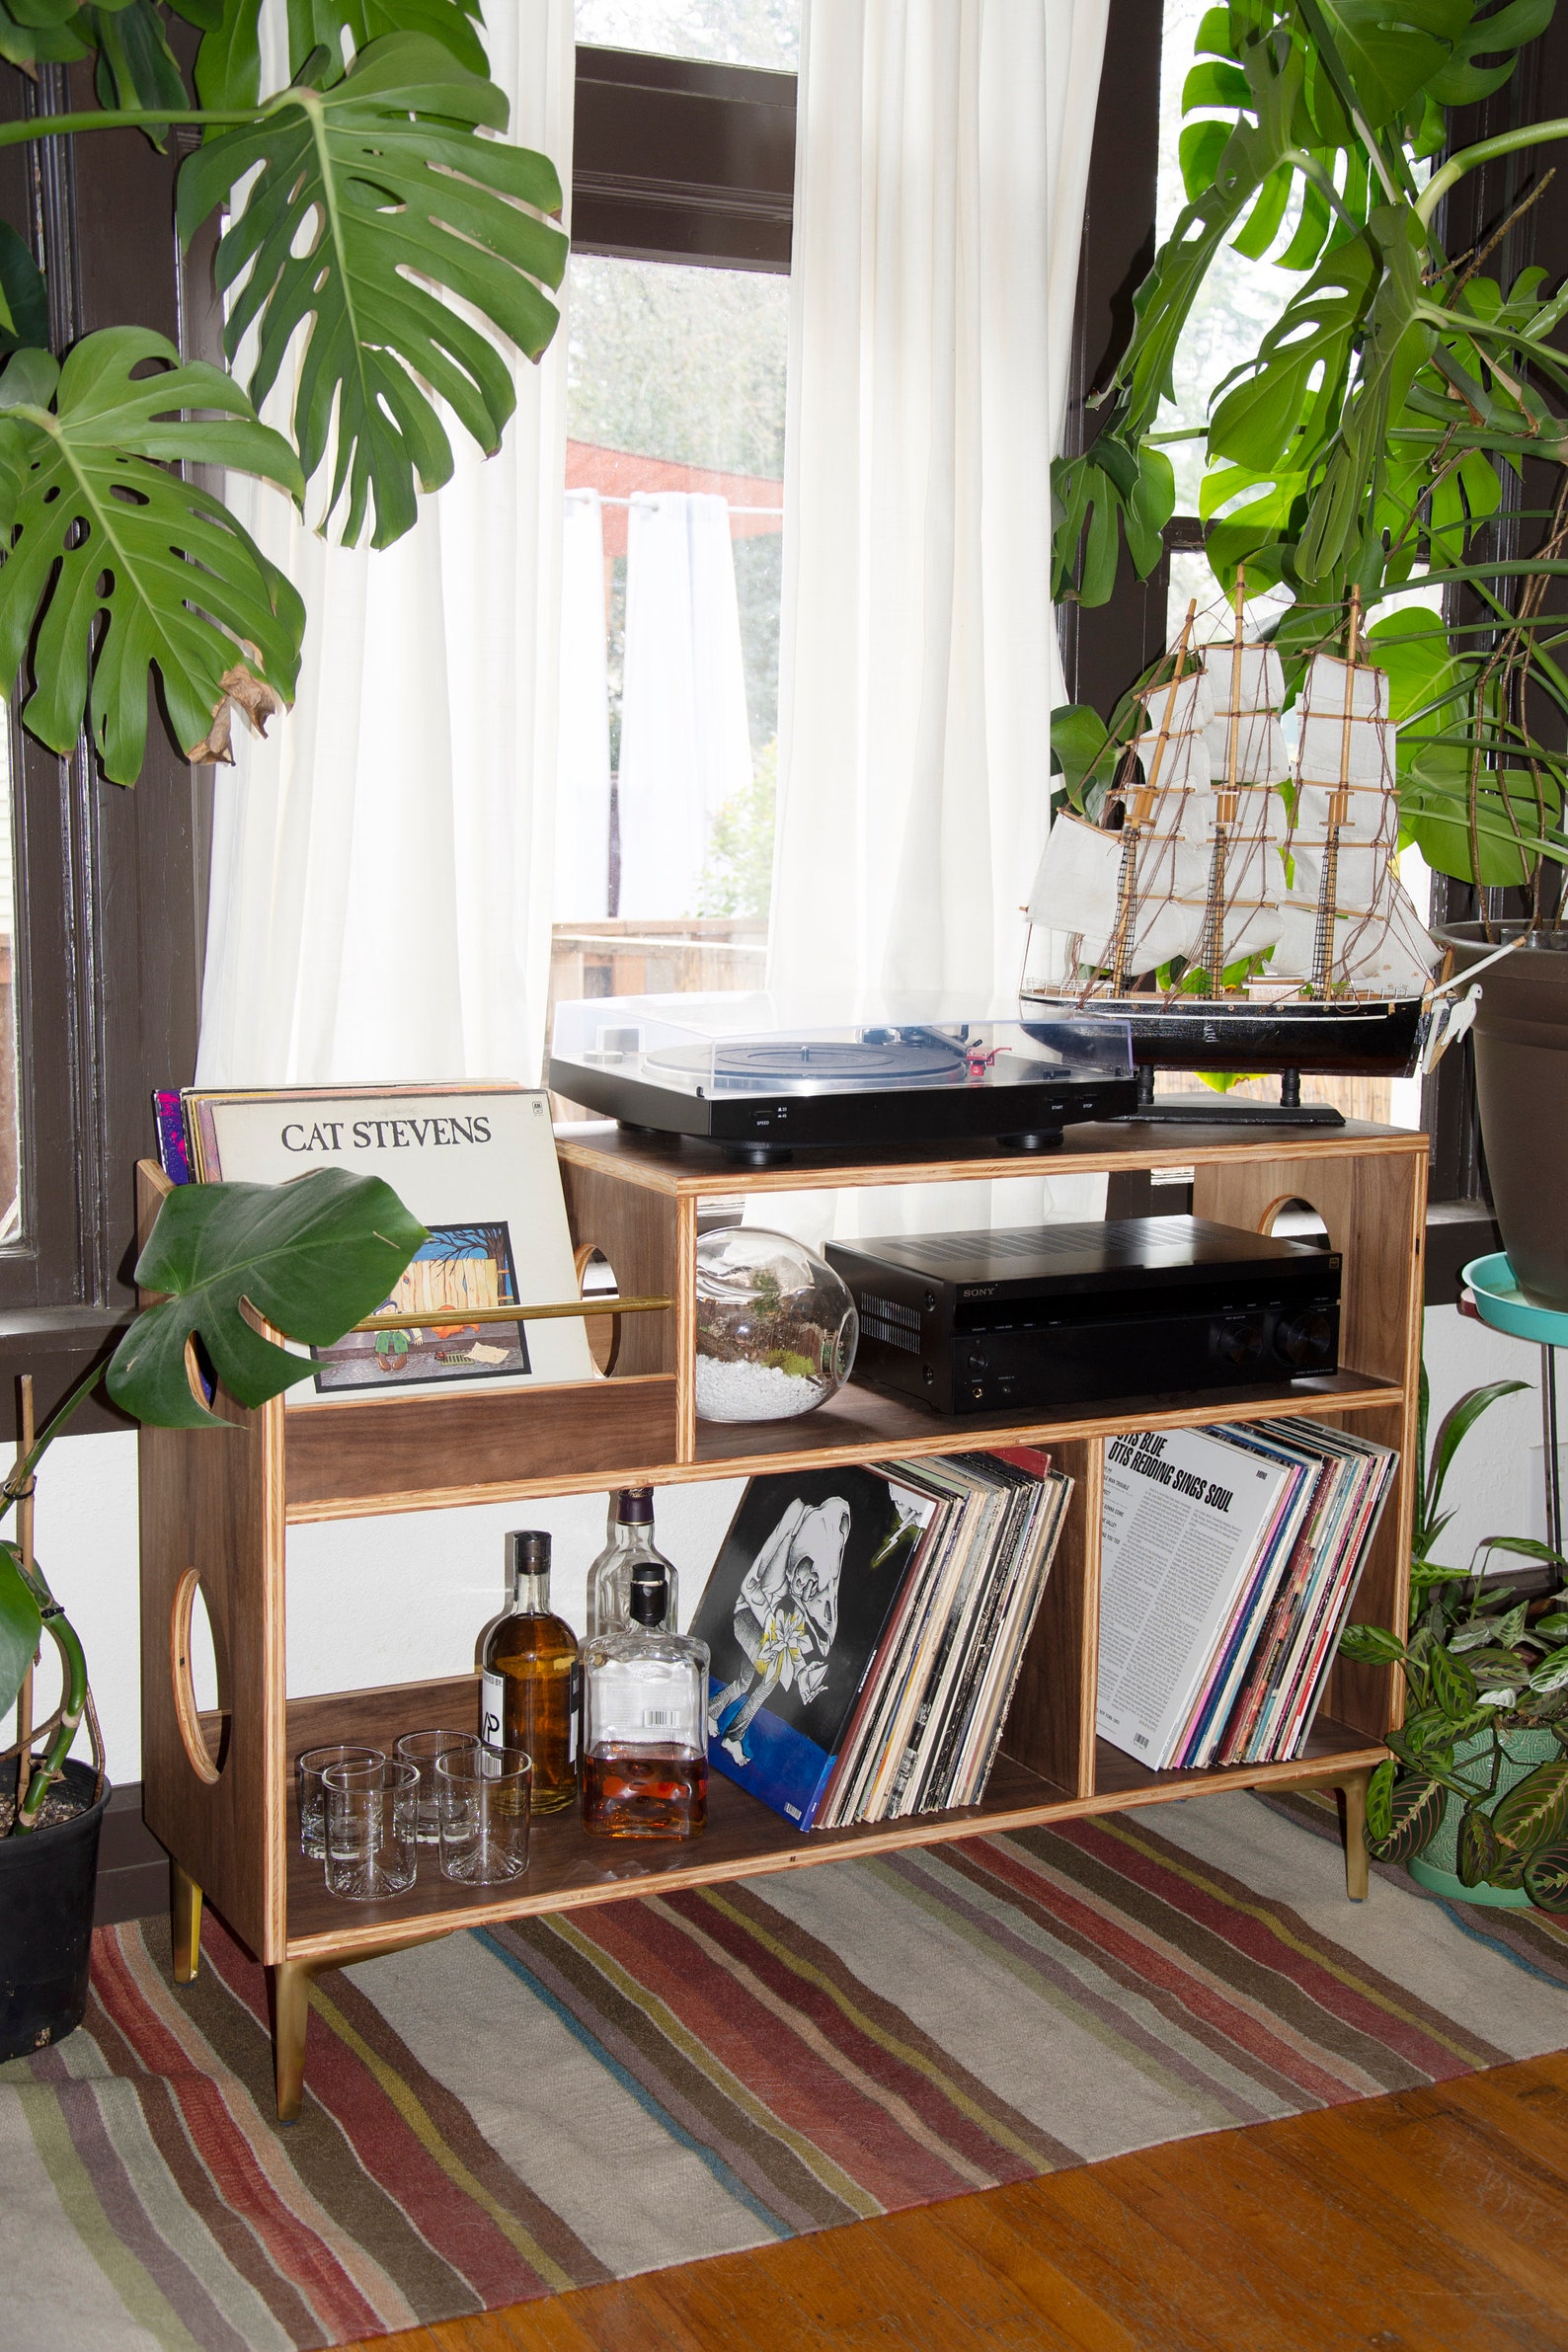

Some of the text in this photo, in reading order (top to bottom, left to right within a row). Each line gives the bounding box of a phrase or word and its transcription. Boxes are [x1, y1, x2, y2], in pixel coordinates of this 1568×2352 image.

[281, 1117, 492, 1151] CAT STEVENS
[964, 1288, 995, 1297] SONY
[1138, 1432, 1168, 1457] BLUE
[1108, 1441, 1234, 1514] OTIS REDDING SINGS SOUL
